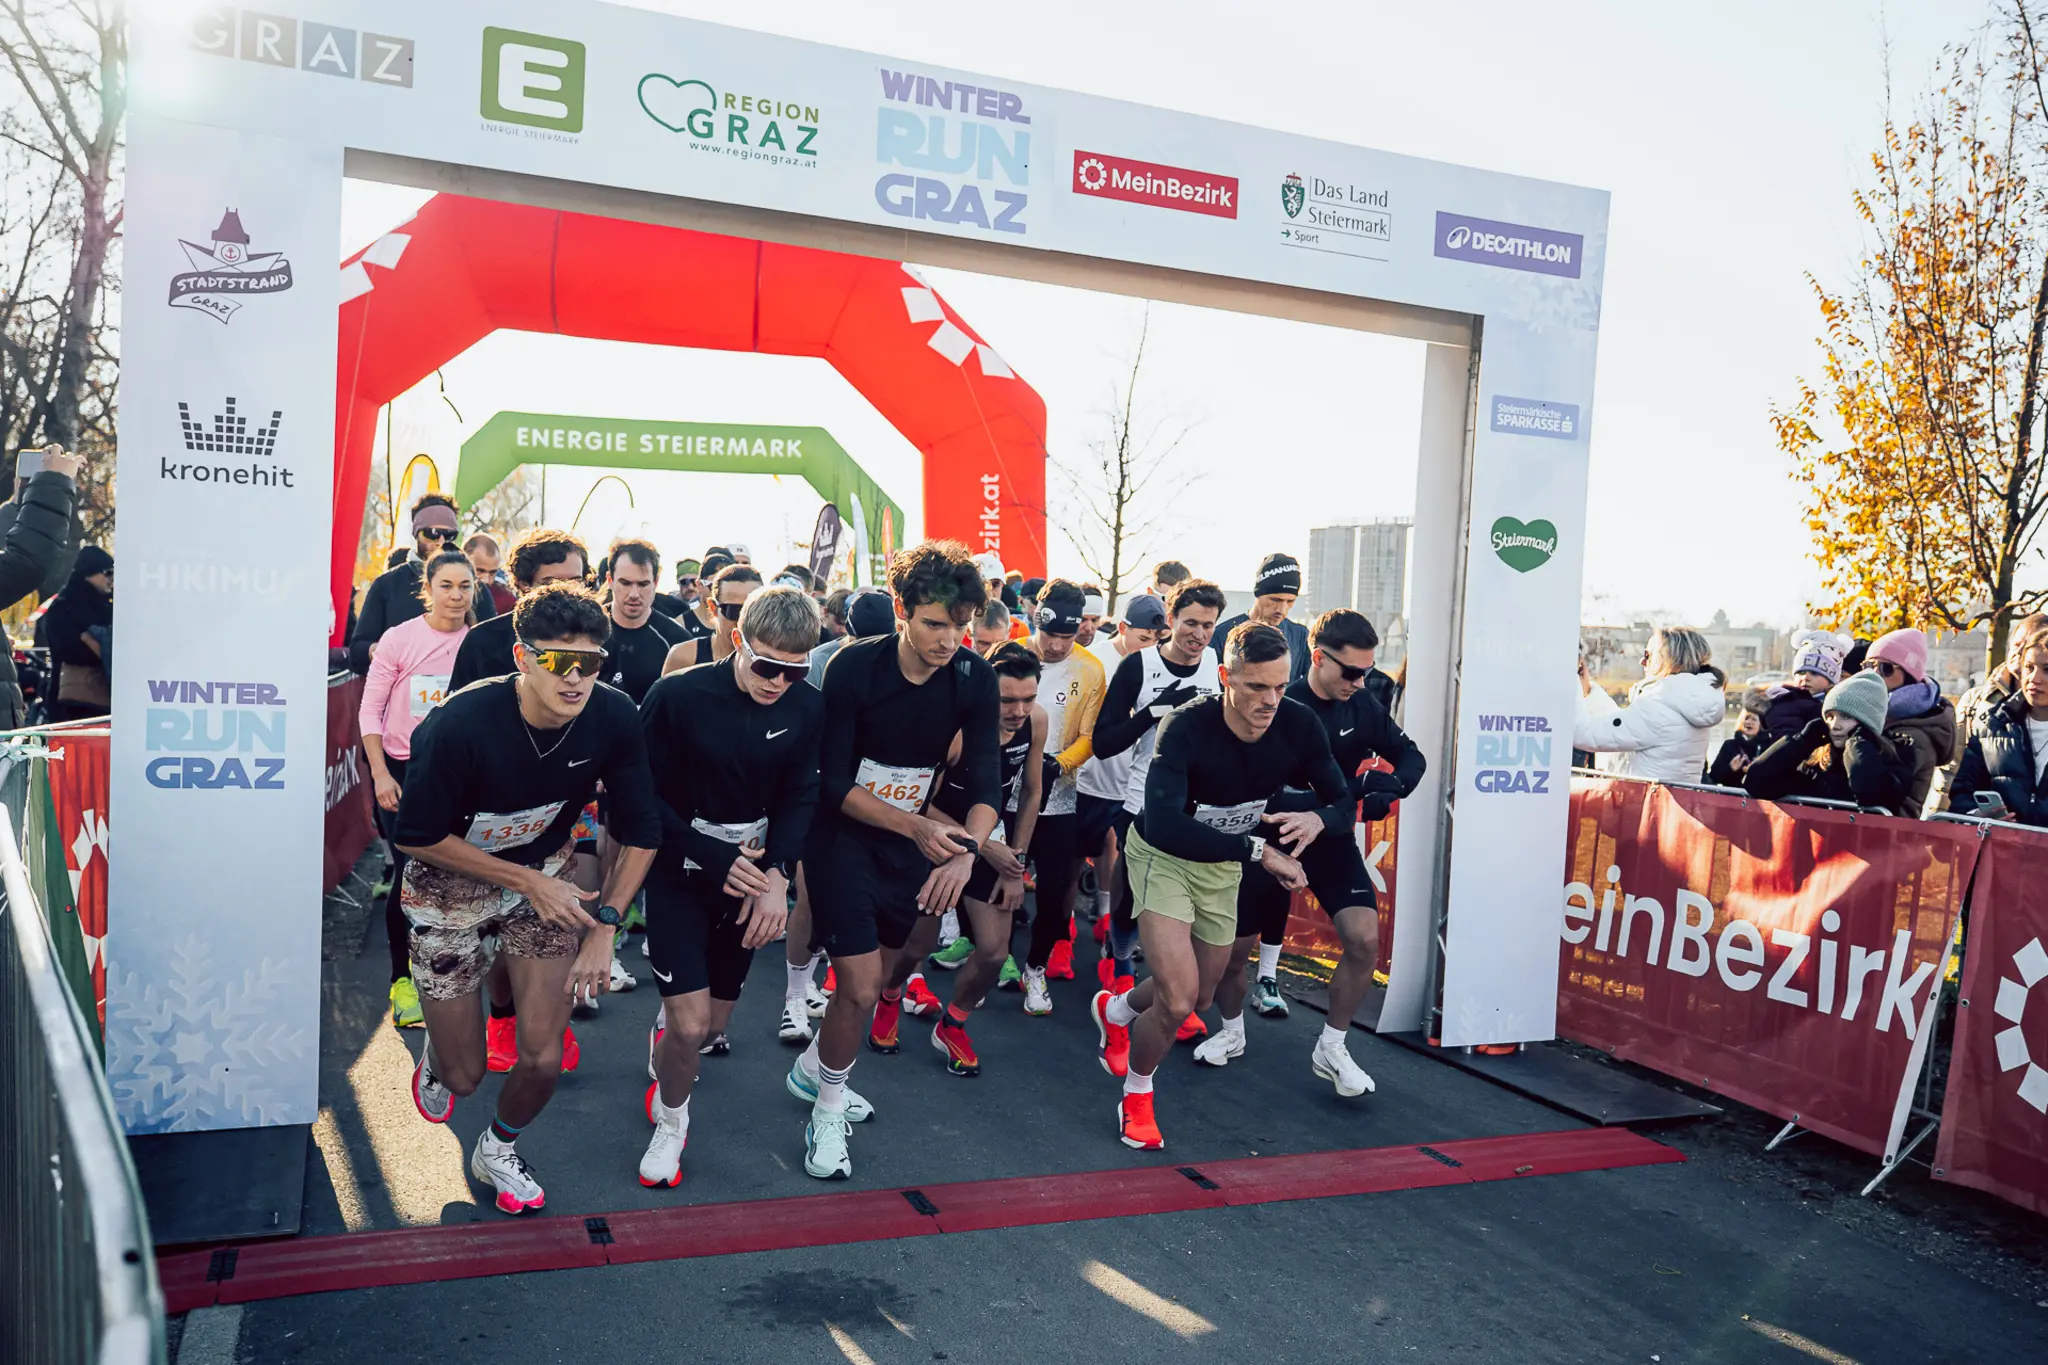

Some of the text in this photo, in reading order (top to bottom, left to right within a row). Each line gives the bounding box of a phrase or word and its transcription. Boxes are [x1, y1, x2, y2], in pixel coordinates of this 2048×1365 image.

[192, 13, 404, 82] GRAZ
[724, 92, 819, 123] REGION
[880, 68, 1031, 124] WINTER
[480, 123, 580, 145] ENERGIE STEIERMARK
[687, 108, 818, 156] GRAZ
[877, 106, 1031, 186] RUN
[689, 141, 817, 168] www.regiongraz.at
[1112, 168, 1232, 208] MeinBezirk
[1314, 178, 1388, 208] Das Land
[875, 174, 1028, 234] GRAZ
[1308, 207, 1388, 236] Steiermark
[1294, 230, 1319, 244] Sport
[1472, 231, 1571, 264] DECATHLON
[176, 273, 289, 291] STADTSTRAND
[191, 295, 230, 314] GRAZ
[1496, 414, 1561, 432] SPARKASSE
[1497, 403, 1562, 419] Steiermärkische
[516, 426, 803, 458] ENERGIE STEIERMARK
[161, 457, 294, 488] kronehit
[1491, 532, 1556, 557] Steiermark
[148, 680, 286, 706] WINTER
[418, 689, 447, 704] 14
[146, 708, 286, 754] RUN
[1478, 714, 1552, 733] WINTER
[1475, 735, 1552, 767] RUN
[145, 756, 286, 790] GRAZ
[1475, 770, 1550, 794] GRAZ
[865, 781, 921, 801] 1462
[480, 818, 546, 841] 1338
[1560, 864, 1937, 1041] einBezirk
